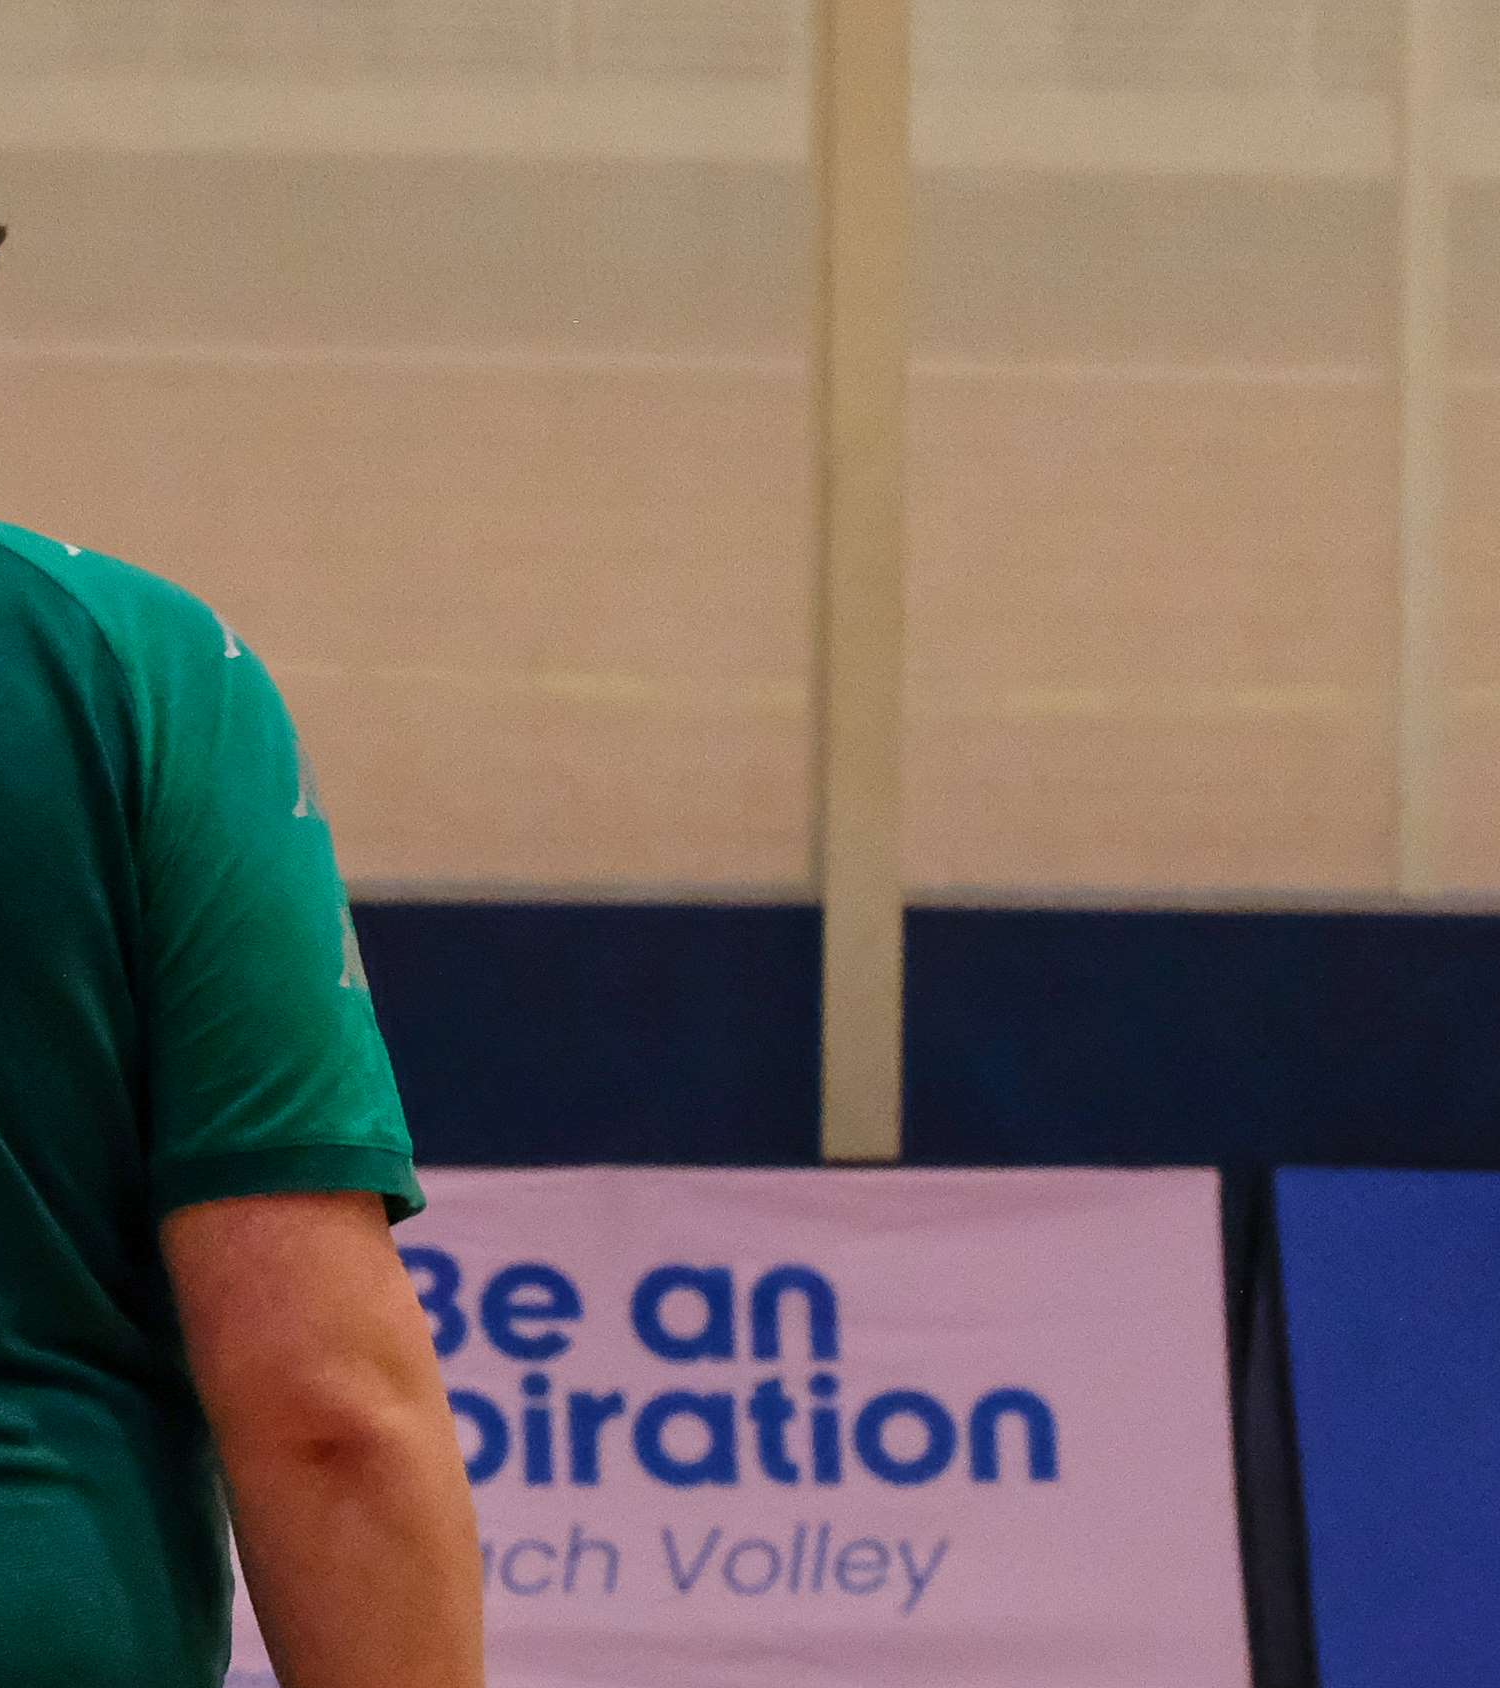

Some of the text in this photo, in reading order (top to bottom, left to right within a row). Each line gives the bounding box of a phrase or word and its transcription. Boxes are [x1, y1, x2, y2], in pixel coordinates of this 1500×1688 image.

[398, 1245, 840, 1363] Be an
[661, 1520, 951, 1615] Volley
